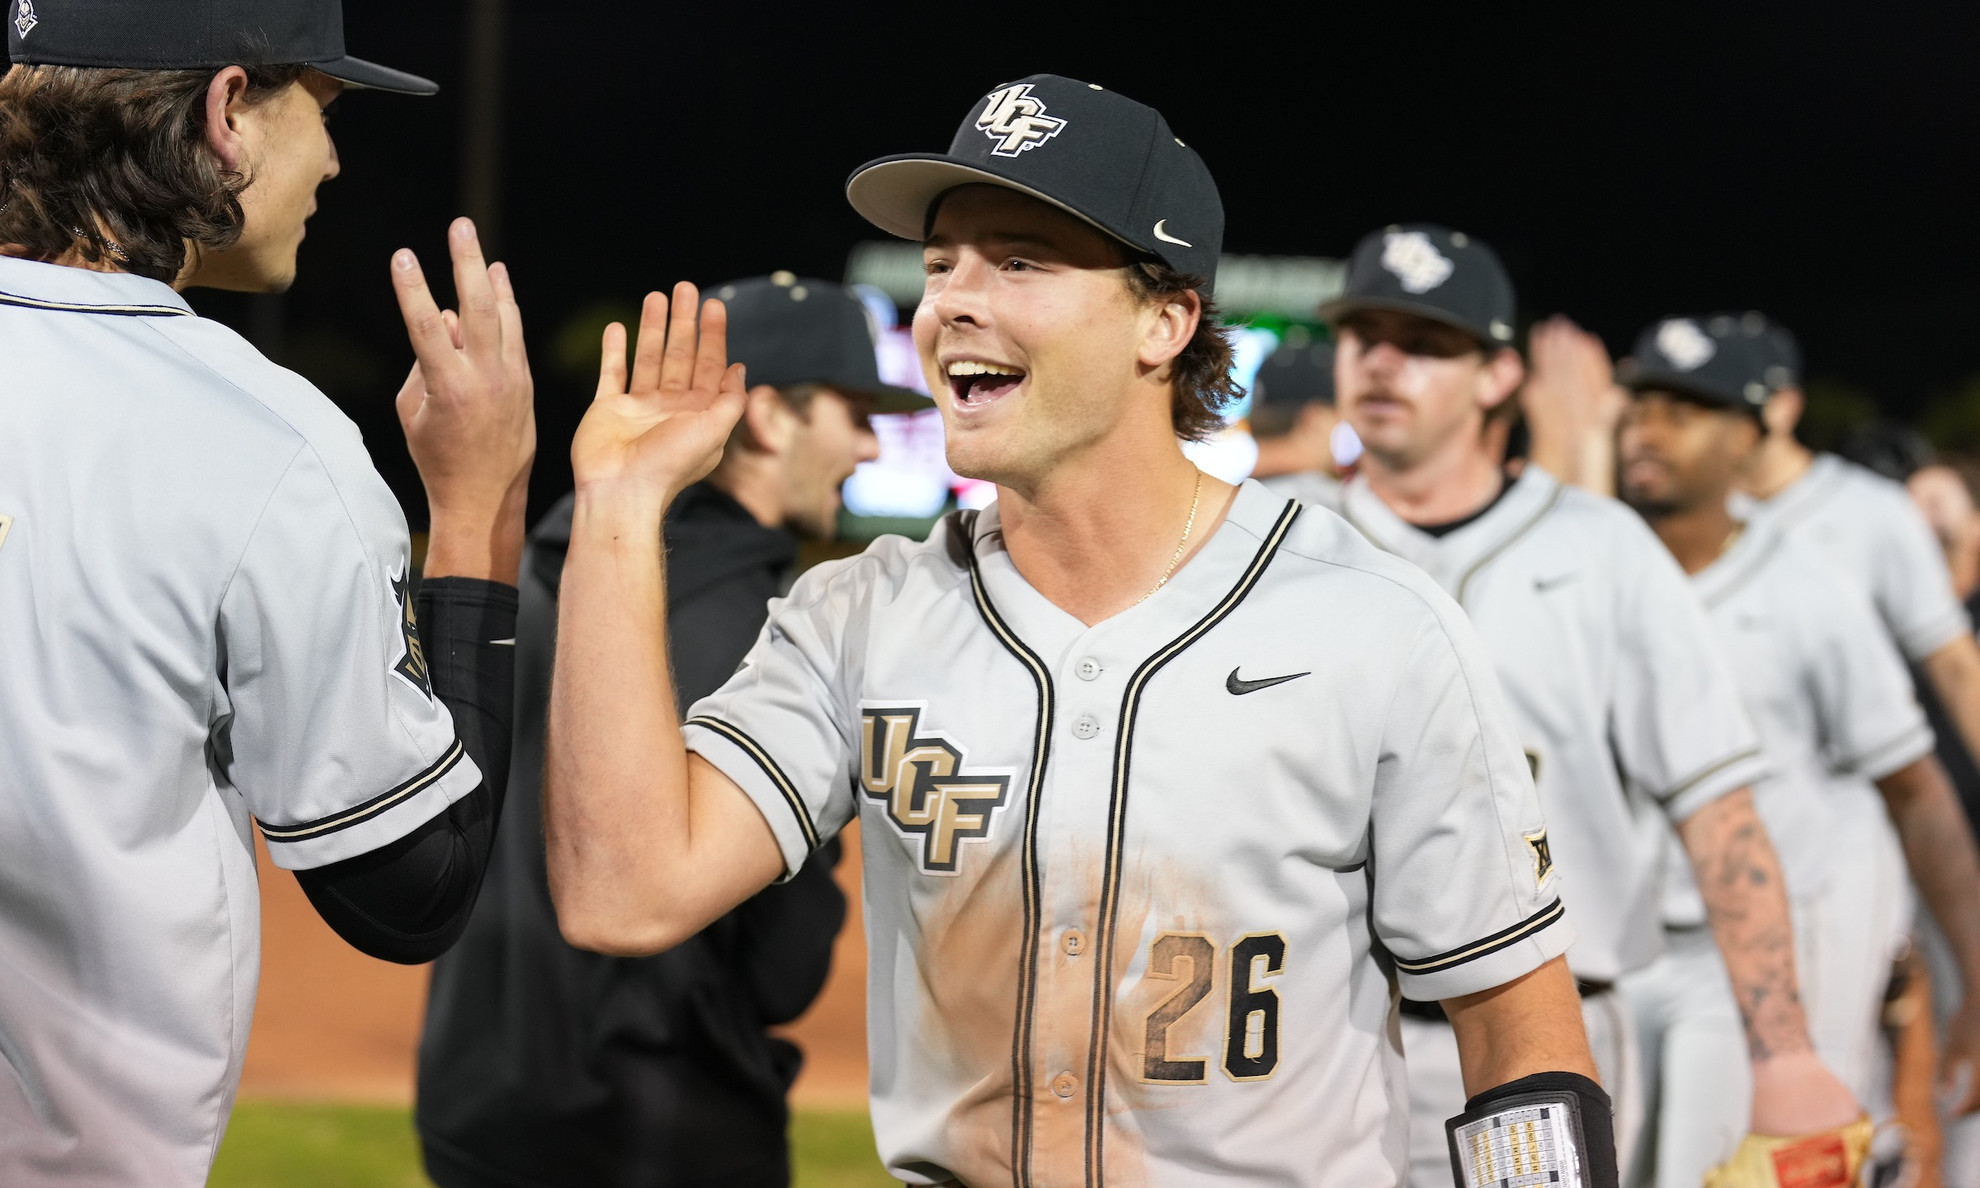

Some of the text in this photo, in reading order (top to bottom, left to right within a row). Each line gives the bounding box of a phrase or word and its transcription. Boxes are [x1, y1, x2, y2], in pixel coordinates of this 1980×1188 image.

[976, 84, 1067, 157] UCF
[860, 702, 1014, 874] UCF
[1140, 931, 1289, 1085] 26
